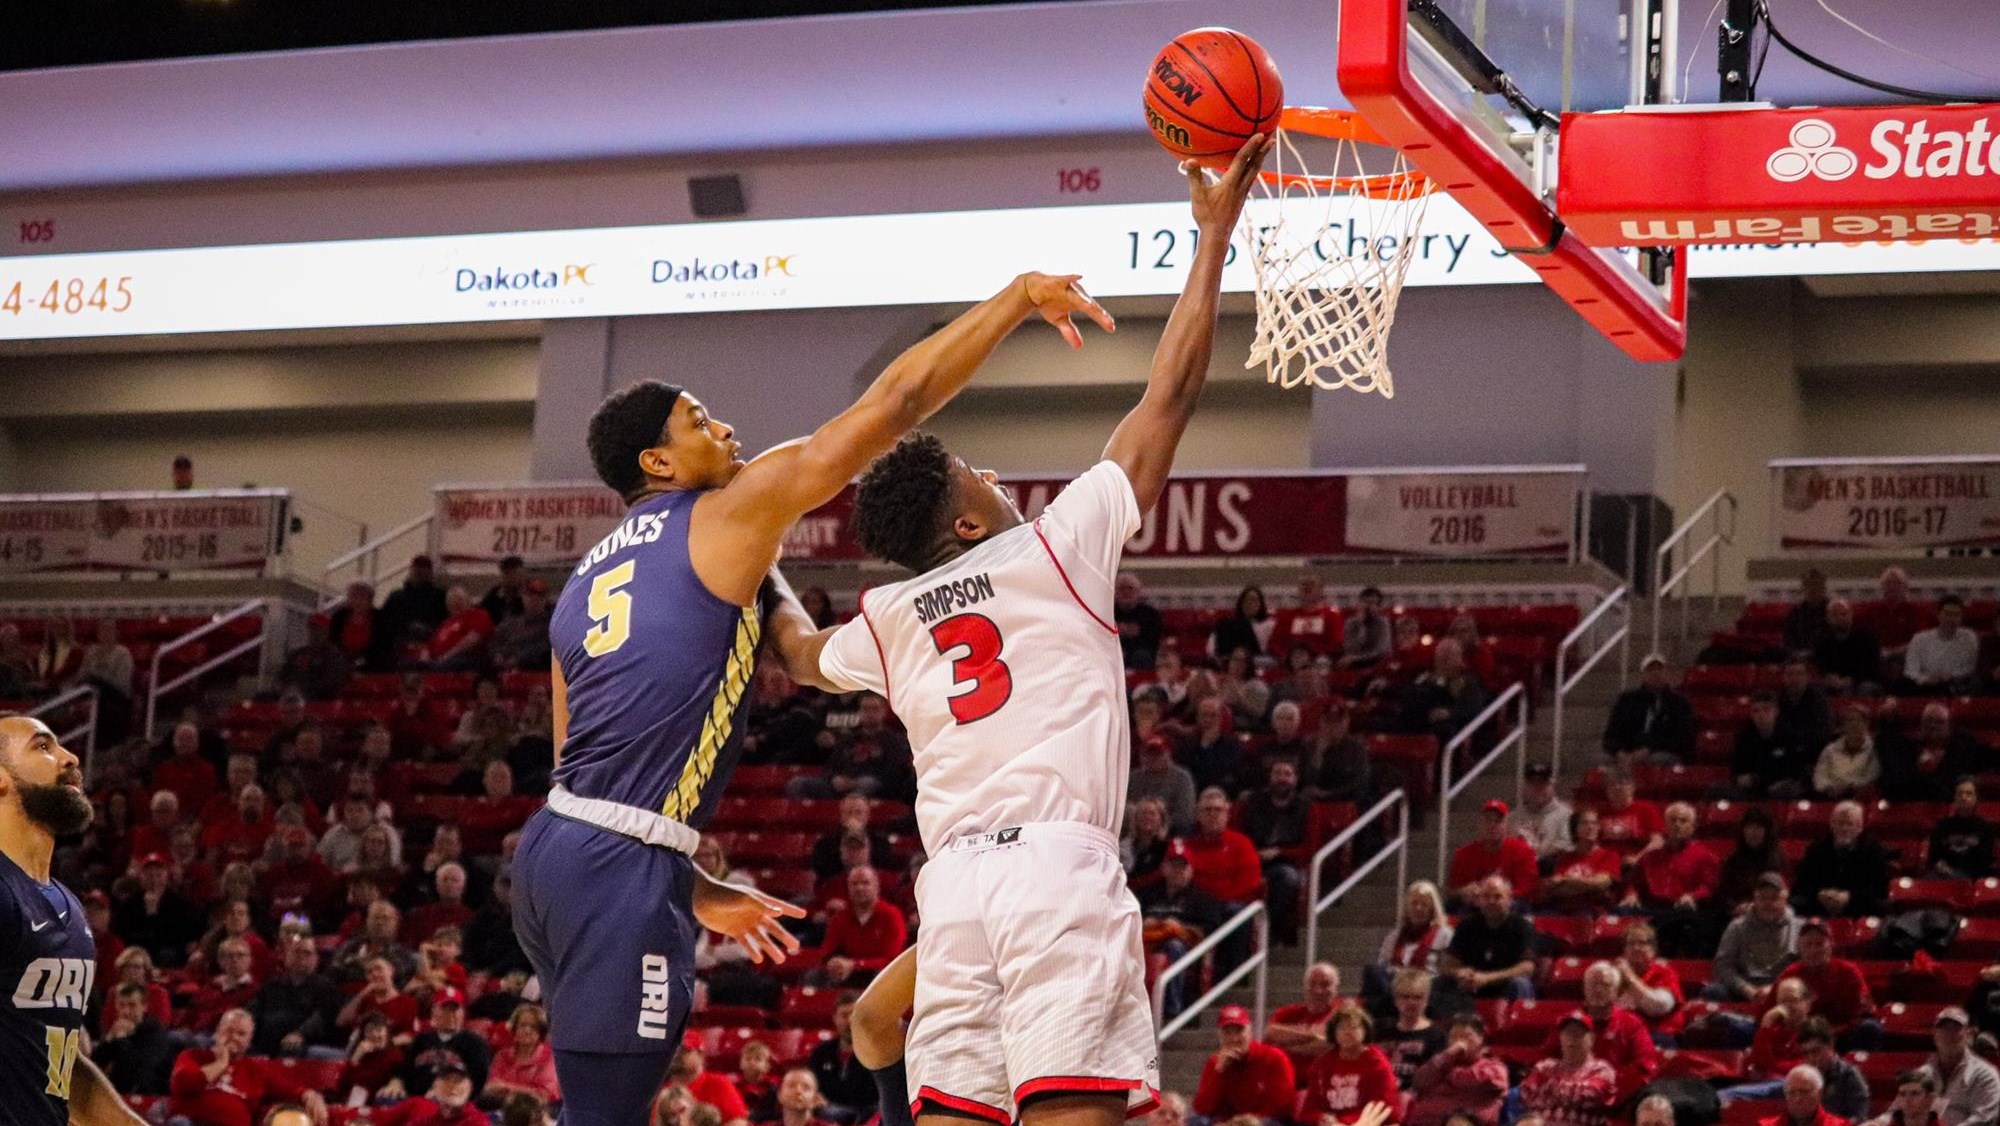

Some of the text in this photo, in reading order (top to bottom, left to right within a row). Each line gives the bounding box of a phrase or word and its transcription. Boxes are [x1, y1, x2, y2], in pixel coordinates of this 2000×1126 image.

[1155, 56, 1203, 107] NCAA
[1058, 167, 1101, 193] 106
[20, 220, 55, 243] 105
[1620, 213, 2000, 241] tate Farm
[2, 275, 133, 316] 4-4845
[1400, 484, 1518, 509] VOLLEYBALL
[1870, 473, 1989, 500] BASKETBALL
[1429, 513, 1487, 545] 2016
[1848, 505, 1949, 538] 2016-17
[142, 533, 218, 561] 2015-16
[491, 524, 576, 552] 2017-18
[576, 510, 670, 576] JONES
[582, 558, 636, 659] 5
[913, 572, 995, 625] SIMPSON
[928, 612, 1013, 726] 3
[637, 953, 669, 1040] ORU
